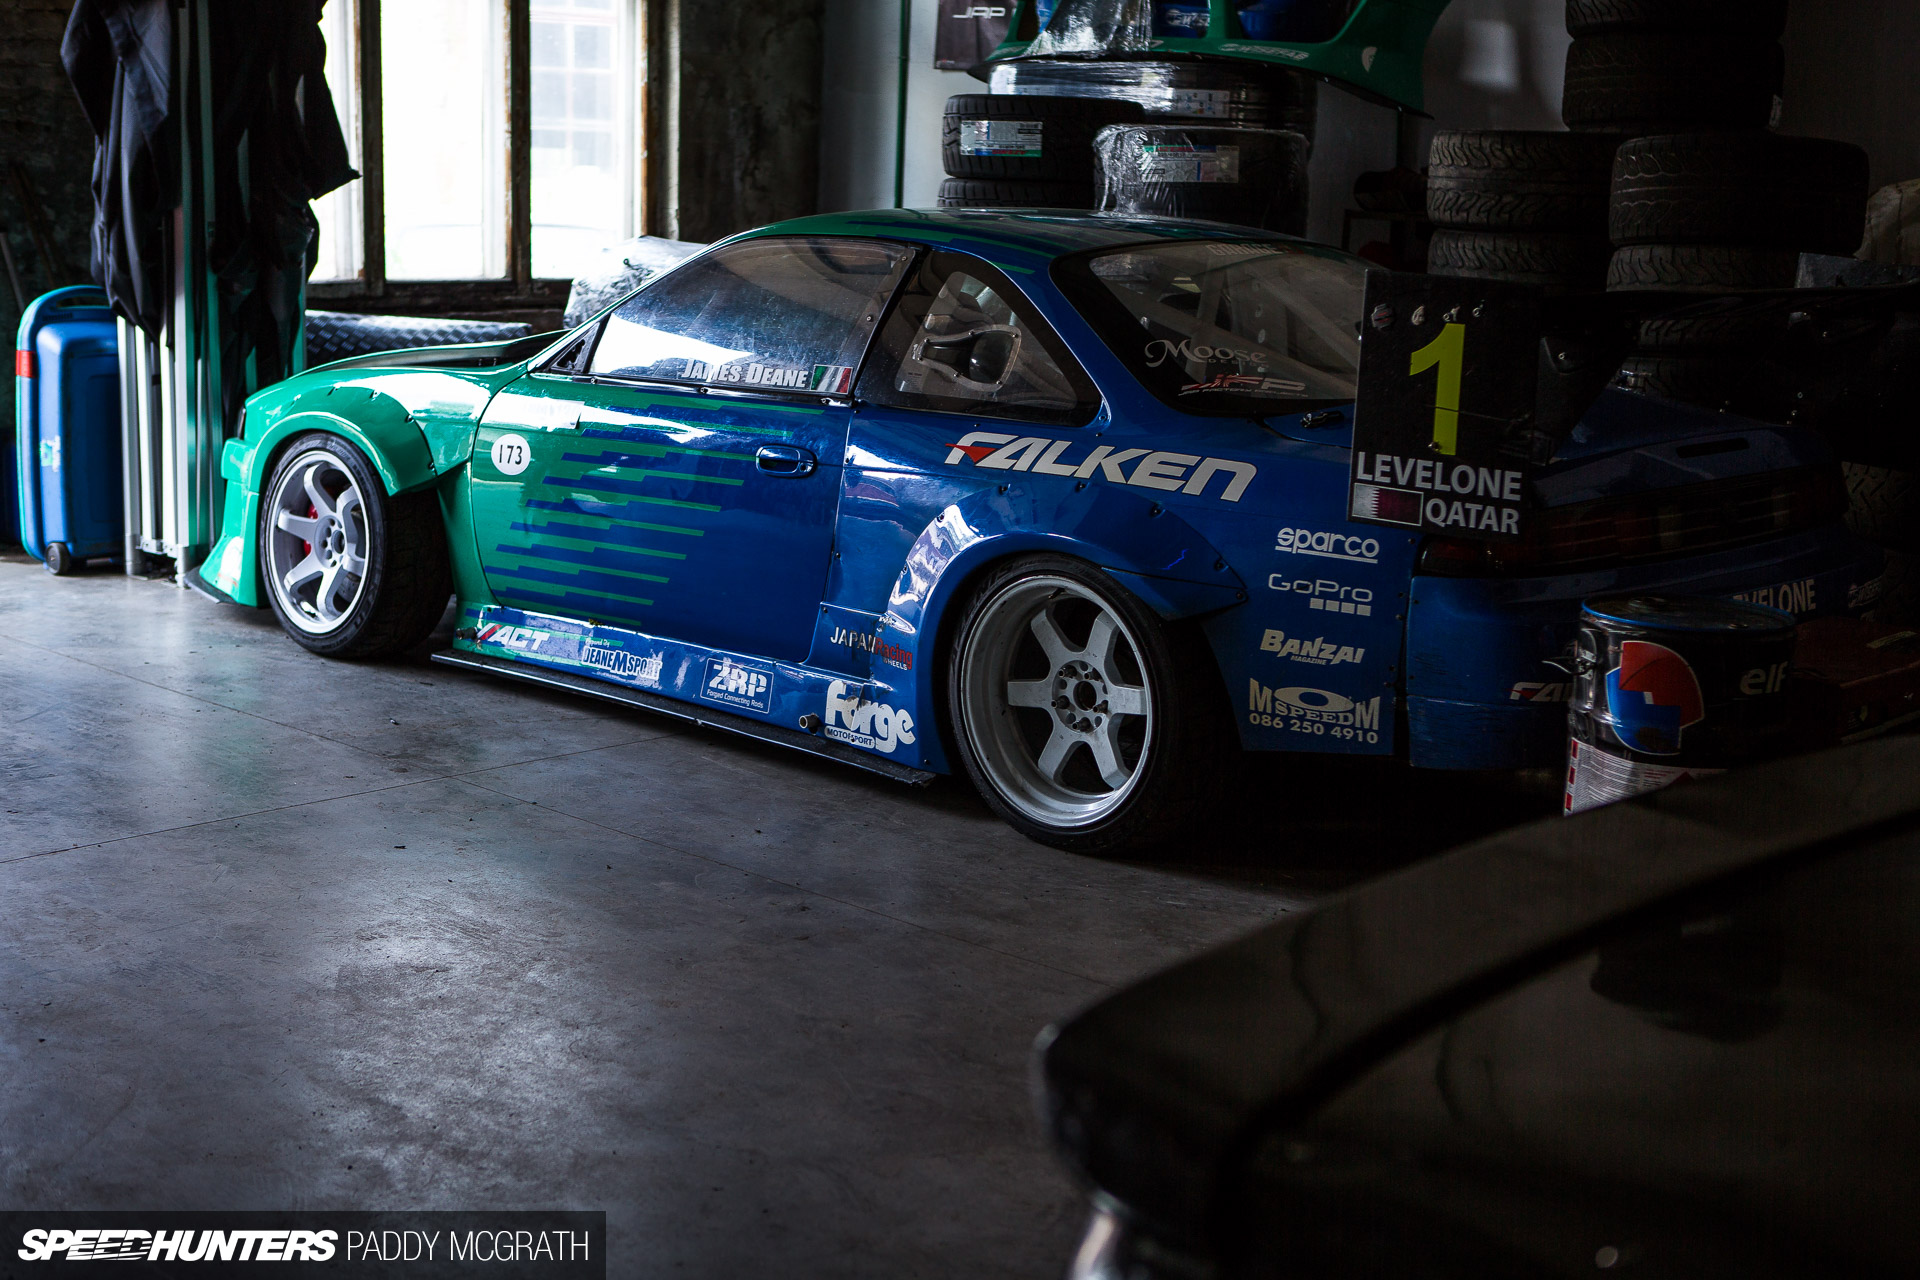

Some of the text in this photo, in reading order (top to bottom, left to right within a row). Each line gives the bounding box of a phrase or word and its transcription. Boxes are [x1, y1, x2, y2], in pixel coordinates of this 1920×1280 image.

[681, 357, 809, 388] JAMES DEANE
[1409, 322, 1466, 456] 1
[499, 443, 523, 466] 173
[944, 430, 1258, 503] FALKEN
[1356, 451, 1523, 501] LEVELONE
[1425, 497, 1521, 535] QATAR
[1276, 527, 1381, 560] sparco
[1267, 572, 1374, 603] GoPro
[1259, 628, 1366, 665] BANZAI
[1290, 655, 1328, 666] MAGAZINE
[708, 663, 768, 698] ZRP
[883, 657, 909, 671] WHEELS
[1739, 660, 1790, 696] elf
[1249, 712, 1379, 745] 086 250 4910
[1275, 700, 1355, 726] SPEED
[826, 727, 874, 747] MOTORSPORT
